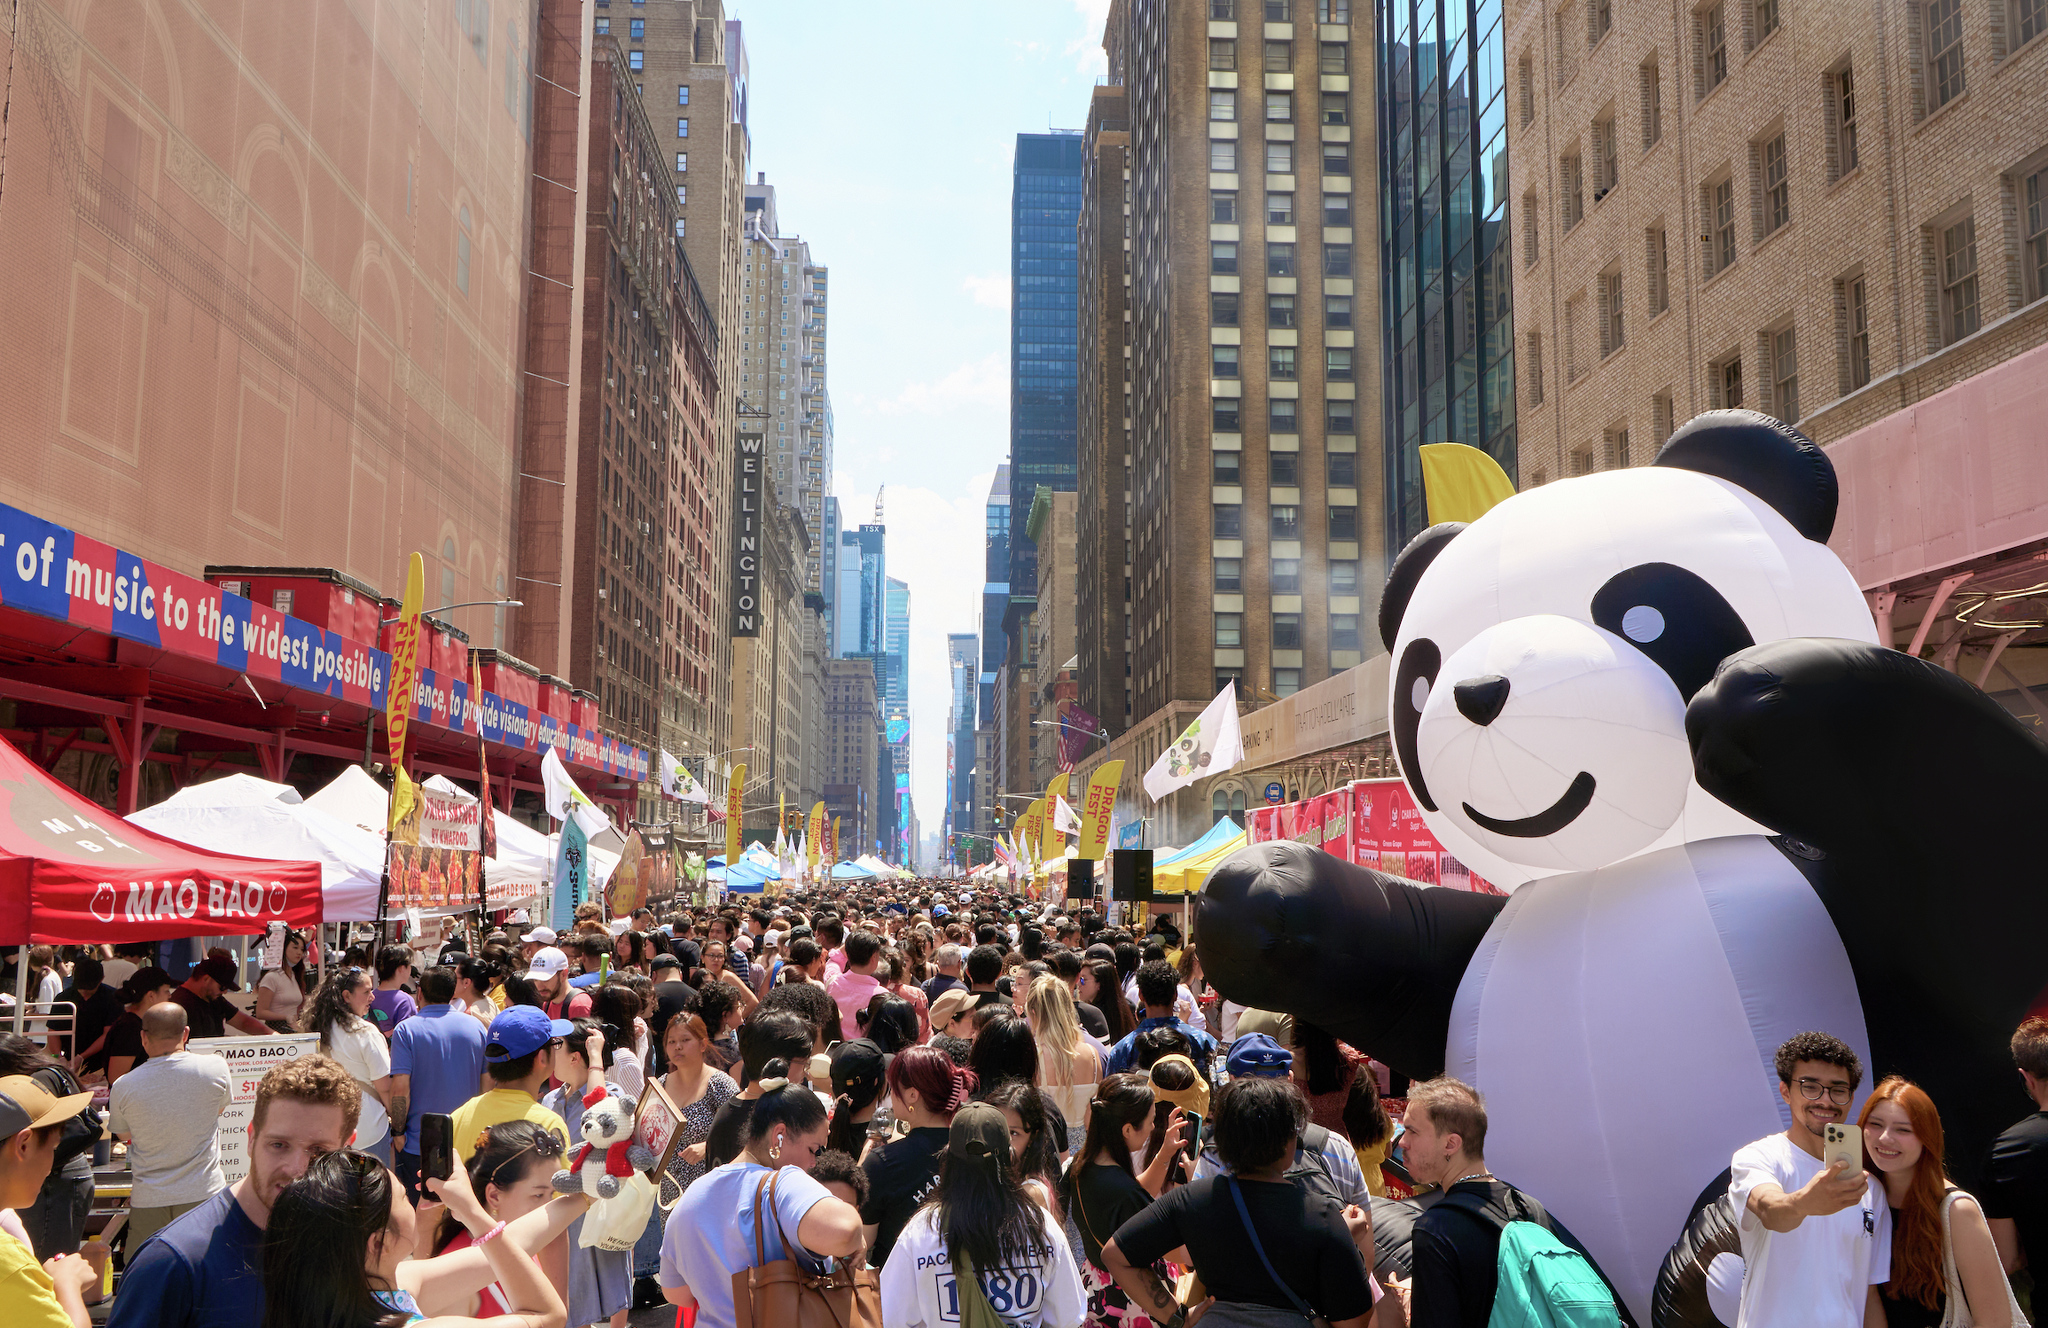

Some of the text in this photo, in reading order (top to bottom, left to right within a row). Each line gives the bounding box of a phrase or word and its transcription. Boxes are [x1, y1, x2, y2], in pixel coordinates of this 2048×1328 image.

[738, 439, 761, 630] WELLINGTON
[864, 525, 880, 533] TSX
[16, 536, 55, 587] of
[65, 557, 155, 620] music
[163, 585, 189, 630] to
[198, 597, 235, 645] the
[242, 614, 309, 669] widest
[313, 649, 381, 692] possible
[410, 671, 446, 719] ience,
[450, 689, 460, 717] to
[462, 698, 498, 728] provide
[500, 705, 537, 746] visionary
[538, 725, 569, 750] education
[570, 735, 598, 764] programs,
[599, 743, 609, 763] and
[609, 745, 615, 763] to
[615, 746, 628, 769] foster
[628, 751, 636, 770] the
[636, 754, 648, 773] future
[1242, 730, 1260, 750] ARKING
[424, 797, 447, 823] FRIED
[729, 787, 737, 820] FEST
[1047, 795, 1057, 823] FEST
[1087, 785, 1102, 818] FEST
[41, 814, 109, 836] MA
[1027, 815, 1035, 836] FEST
[1095, 786, 1115, 845] DRAGON
[431, 828, 468, 846] BY KWAFOOD
[812, 818, 821, 855] DRAGON
[1323, 811, 1346, 843] Juice
[75, 837, 141, 854] BA
[1392, 840, 1402, 848] Grape
[1413, 839, 1432, 848] Strawberry
[520, 883, 537, 896] BOBA
[125, 879, 264, 923] MAO BAO
[226, 1047, 285, 1059] MAO BAO
[219, 1126, 246, 1134] HICK
[221, 1143, 239, 1151] EEF
[220, 1158, 239, 1166] AMB
[912, 1174, 941, 1203] HAR
[917, 1252, 950, 1270] PAC
[943, 1273, 1037, 1315] 180
